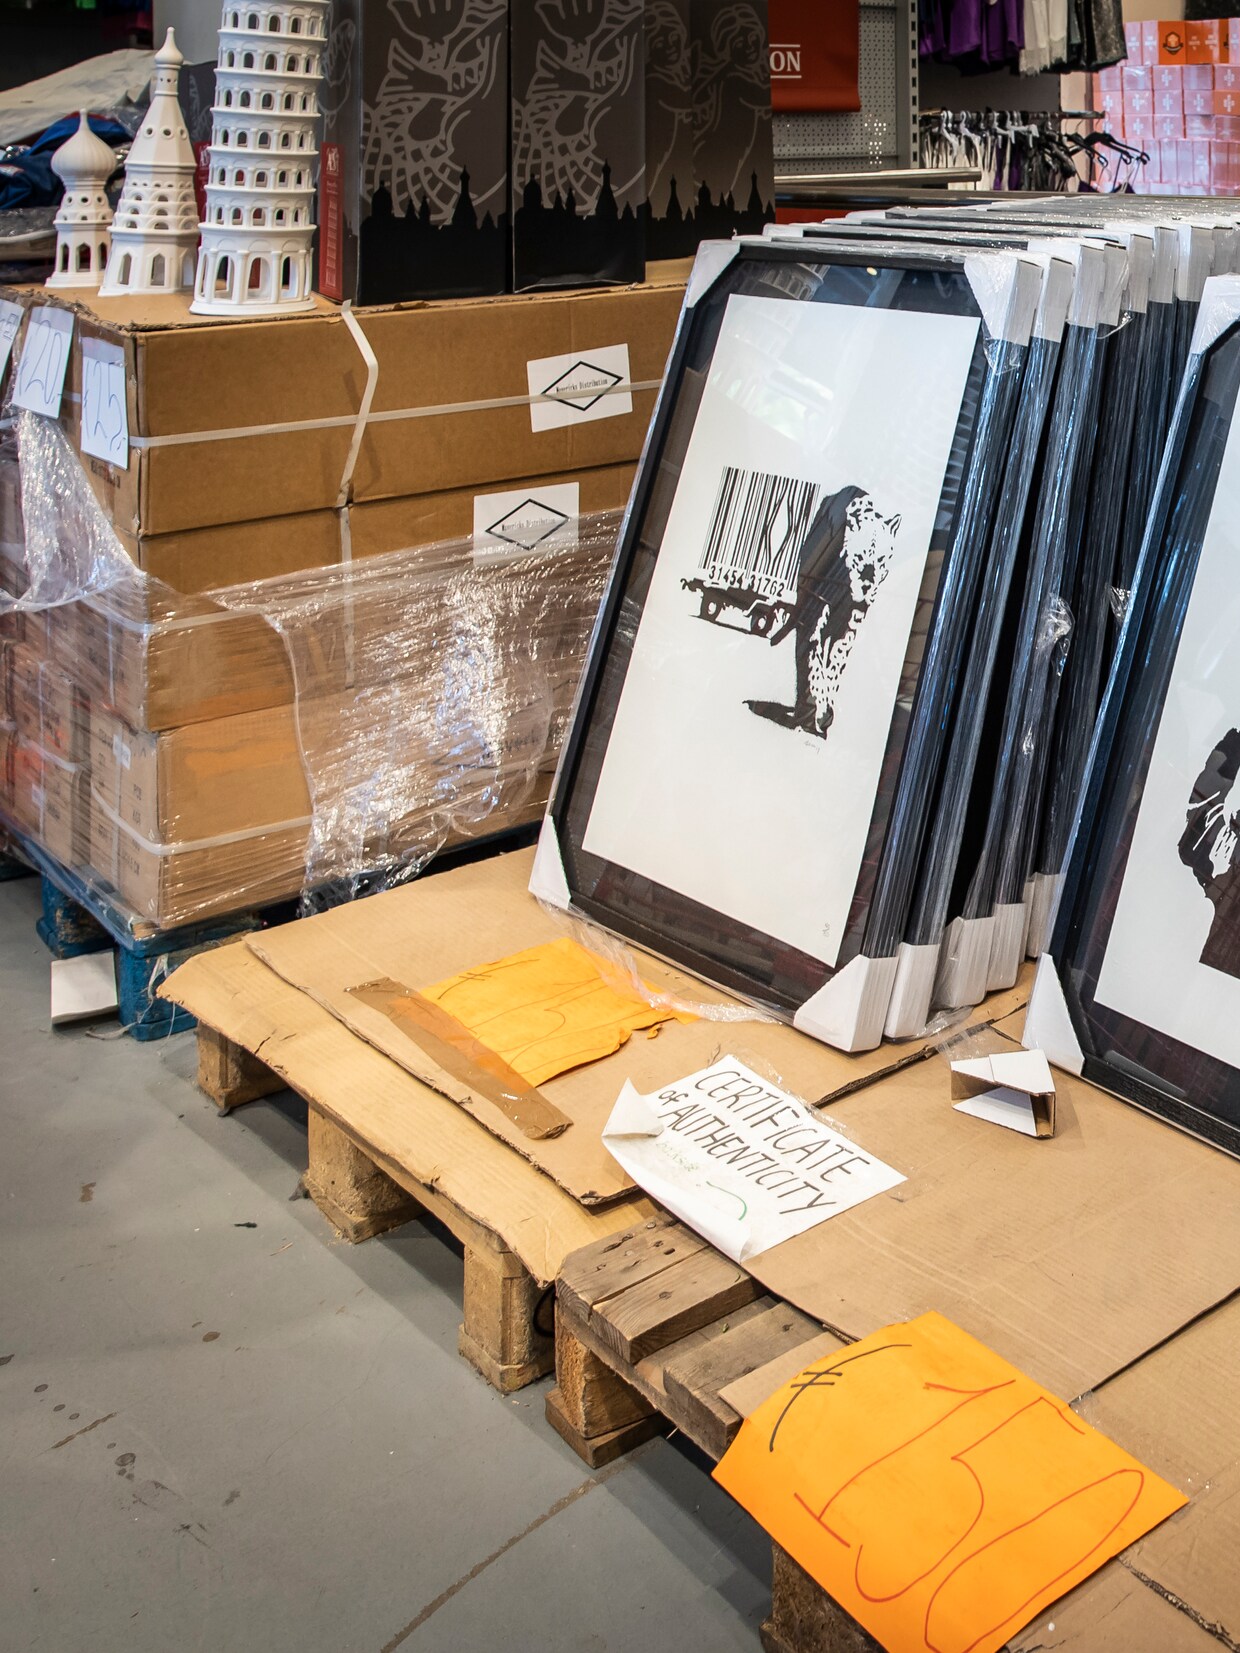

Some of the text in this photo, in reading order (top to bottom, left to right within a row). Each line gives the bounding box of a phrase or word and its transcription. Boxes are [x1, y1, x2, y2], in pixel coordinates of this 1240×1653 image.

[708, 565, 785, 598] 31454 31762
[657, 1103, 837, 1214] AUTHENTICITY
[694, 1070, 871, 1183] CERTIFICATE
